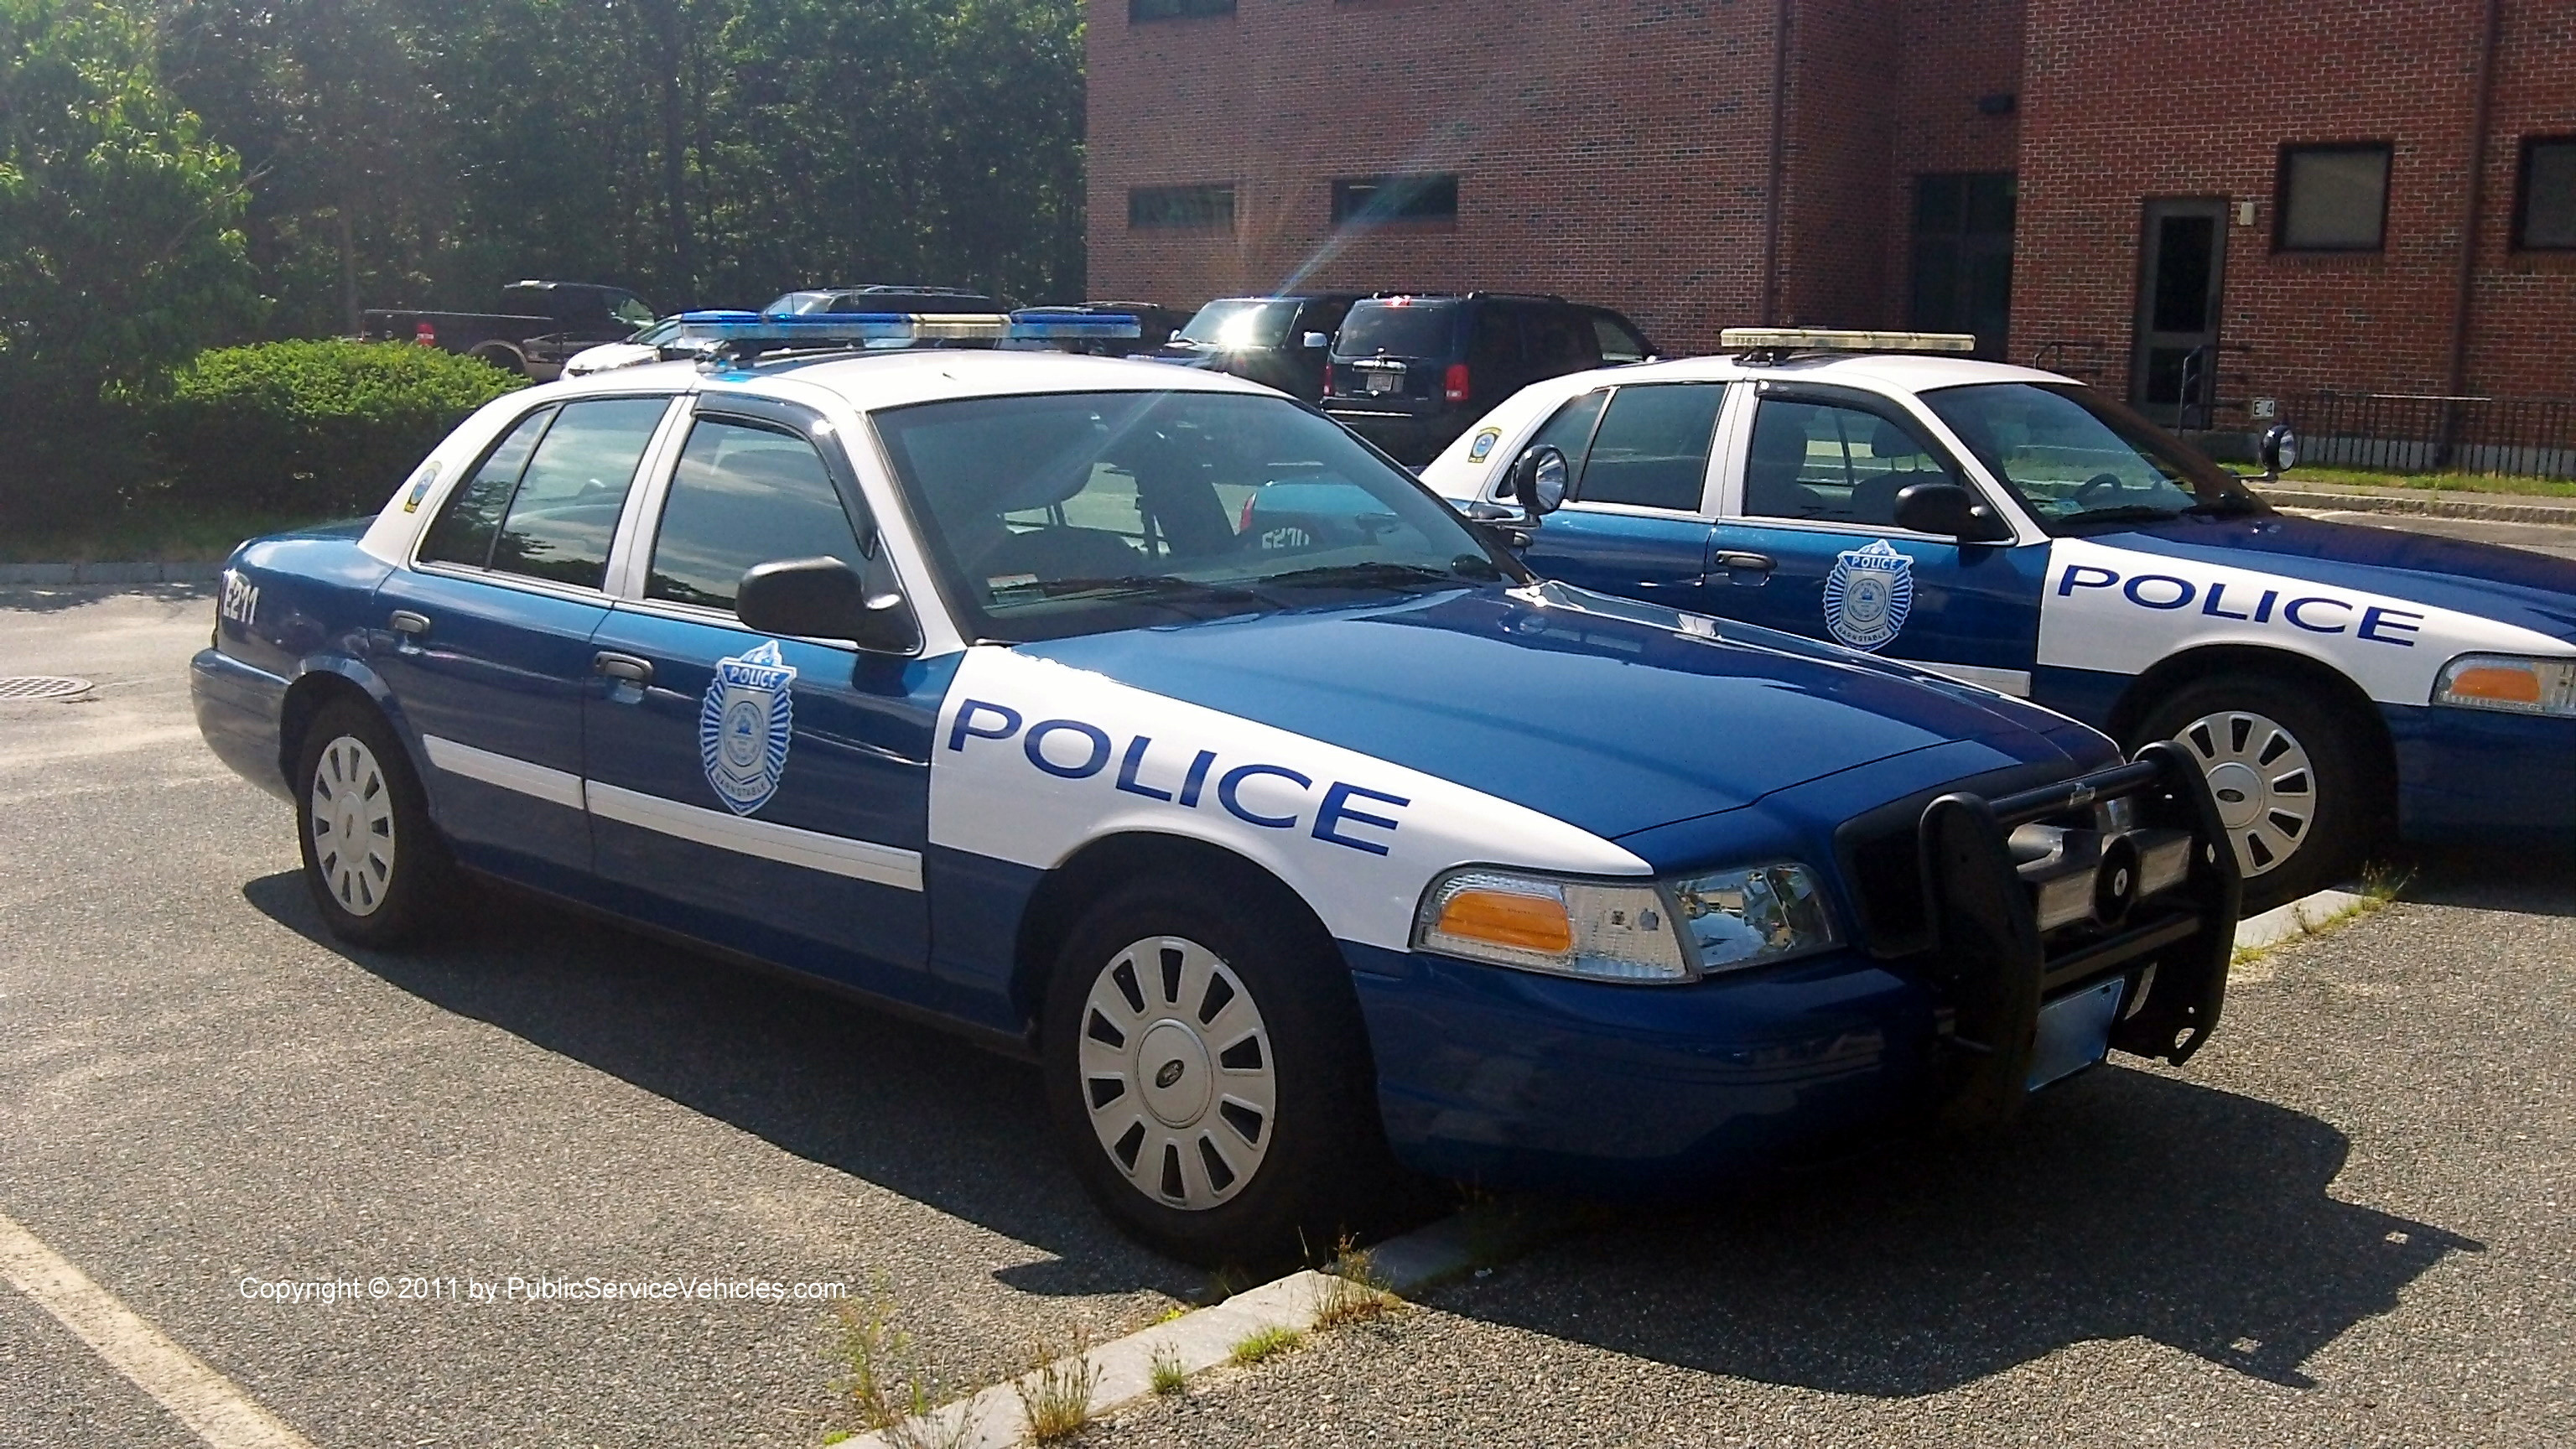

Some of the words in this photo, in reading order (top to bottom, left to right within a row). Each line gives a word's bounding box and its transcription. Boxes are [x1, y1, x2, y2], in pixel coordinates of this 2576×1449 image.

[2253, 401, 2261, 416] E
[2267, 402, 2273, 415] 4
[1851, 556, 1898, 570] POLICE
[2057, 564, 2425, 647] POLICE
[729, 667, 780, 688] POLICE
[947, 698, 1412, 858] POLICE
